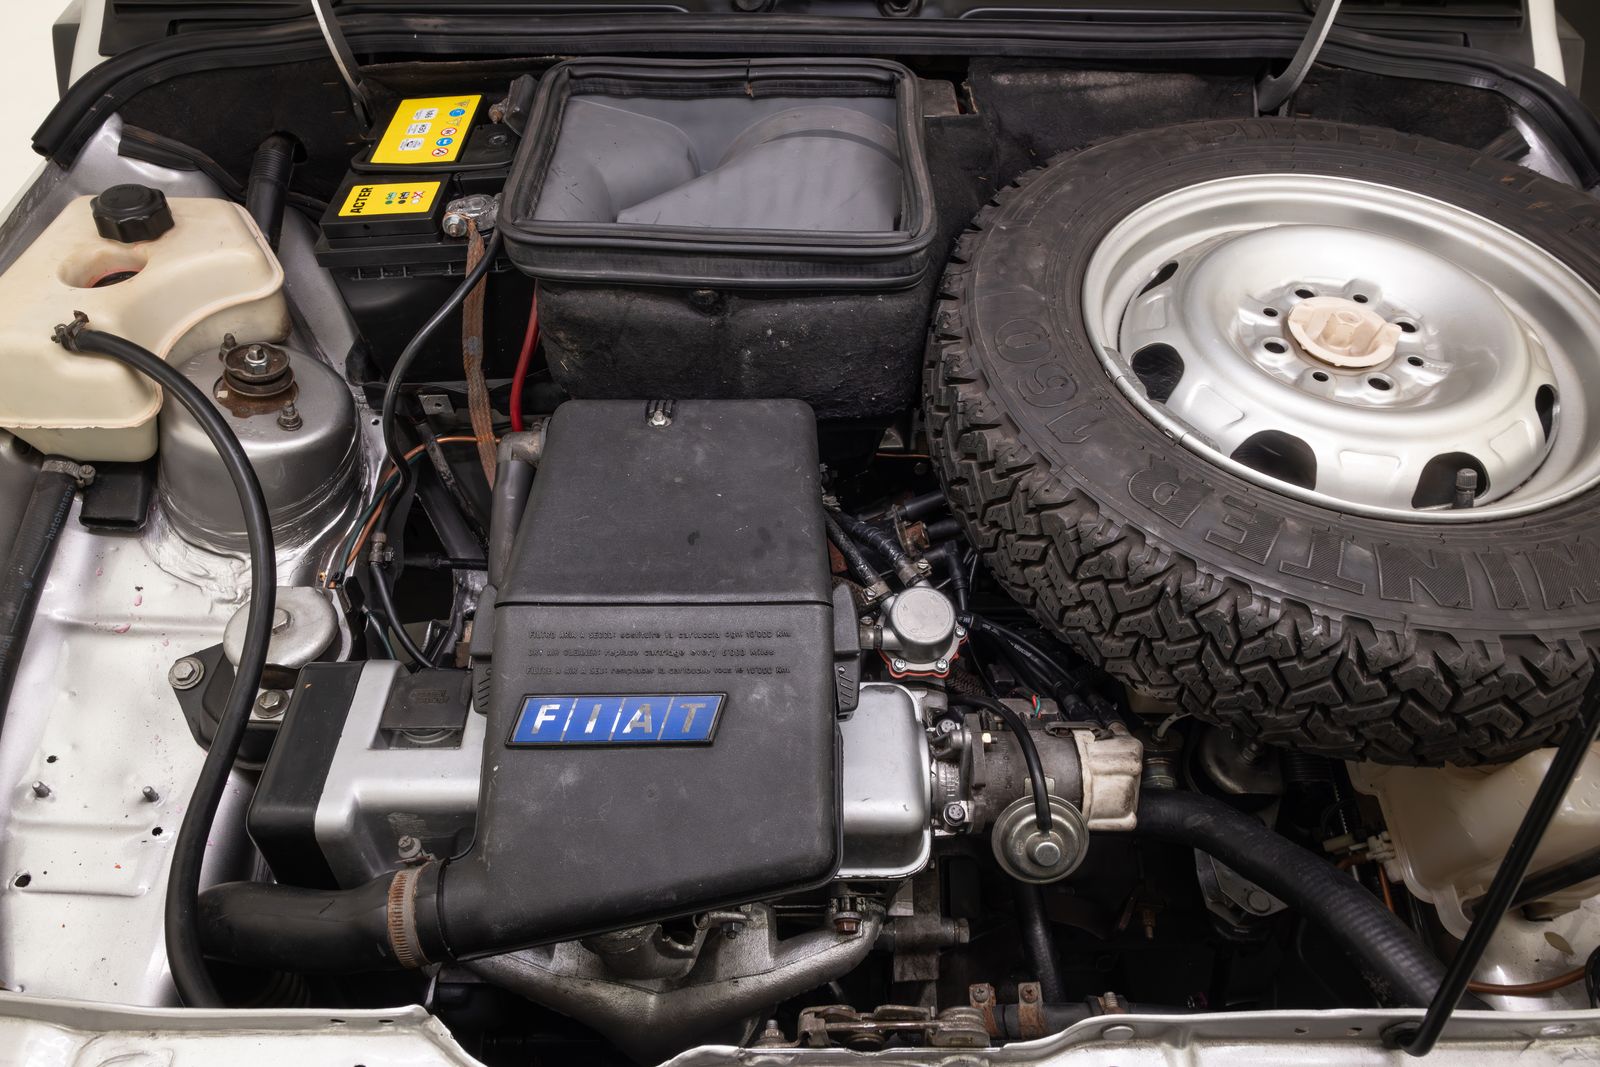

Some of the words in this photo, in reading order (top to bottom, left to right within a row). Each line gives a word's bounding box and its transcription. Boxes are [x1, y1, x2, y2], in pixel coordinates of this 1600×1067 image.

[350, 187, 374, 214] ACTER
[994, 319, 1103, 443] 160
[45, 483, 76, 541] hutchinson
[604, 649, 639, 659] replace
[644, 649, 686, 658] cartridge
[689, 649, 717, 658] every
[530, 703, 707, 735] FIAT
